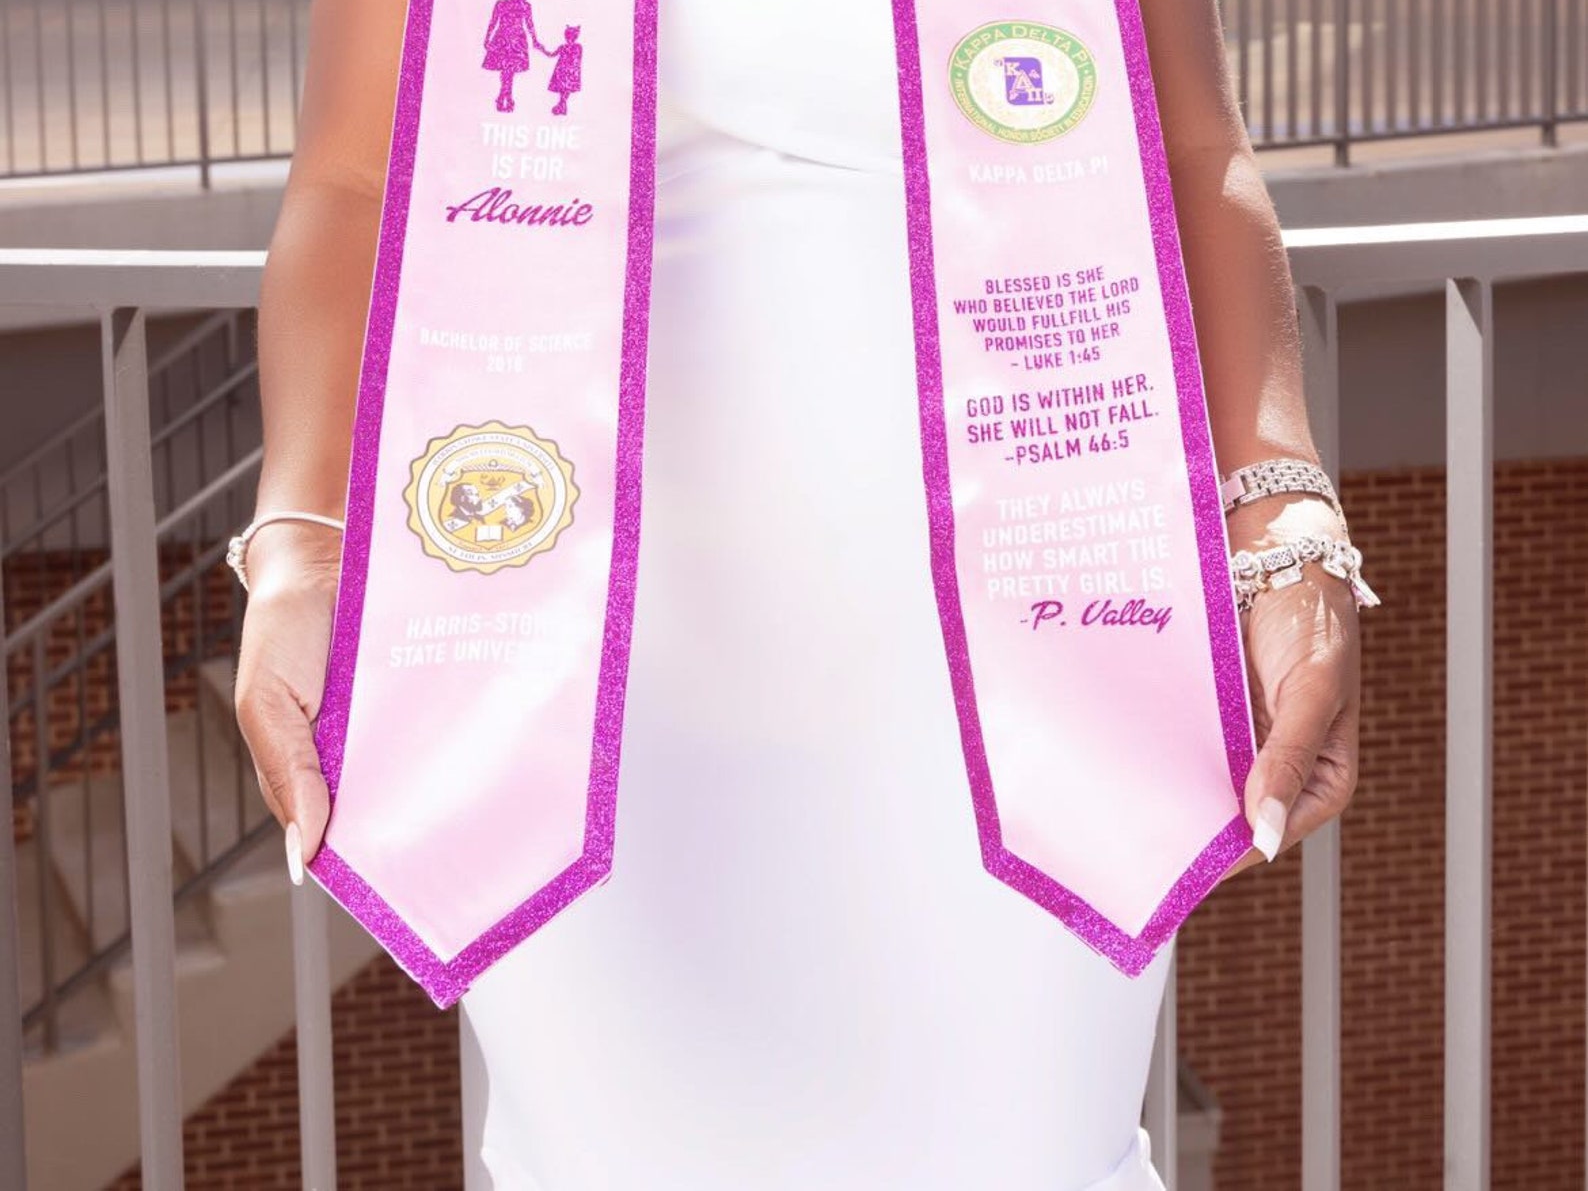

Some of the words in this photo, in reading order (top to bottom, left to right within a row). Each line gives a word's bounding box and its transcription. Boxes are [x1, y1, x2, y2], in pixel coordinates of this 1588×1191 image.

[955, 28, 1006, 70] KAPPA
[1012, 24, 1072, 54] DELTA
[481, 122, 529, 148] THIS
[535, 124, 582, 150] ONE
[492, 153, 513, 179] IS
[520, 154, 563, 180] FOR
[967, 162, 1027, 184] KAPPA
[1032, 159, 1085, 184] DELTA
[1090, 154, 1108, 176] PI
[446, 187, 594, 226] Alonnie
[953, 298, 987, 314] WHO
[993, 293, 1064, 313] BELIEVED
[1070, 287, 1097, 305] THE
[1101, 277, 1139, 300] LORD
[985, 275, 1051, 294] BLESSED
[1056, 273, 1071, 288] IS
[1076, 266, 1104, 285] SHE
[972, 316, 1026, 333] WOULD
[1032, 307, 1101, 330] FULLFILL
[1106, 300, 1131, 318] HIS
[420, 327, 498, 352] BACHELOR
[504, 335, 522, 352] OF
[528, 332, 594, 353] SCIENCE
[985, 332, 1062, 352] PROMISES
[1067, 329, 1085, 345] TO
[1091, 322, 1120, 342] HER
[1024, 351, 1063, 370] LUKE
[1069, 346, 1101, 365] 1:45
[967, 395, 1004, 418] GOD
[1012, 393, 1030, 412] IS
[1037, 383, 1105, 410] WITHIN
[1112, 373, 1154, 398] HER.
[967, 422, 1004, 444] SHE
[1010, 416, 1058, 438] WILL
[1065, 409, 1100, 432] NOT
[1108, 399, 1159, 425] FALL.
[1088, 430, 1129, 453] 46:5
[996, 494, 1051, 522] THEY
[1060, 479, 1146, 514] ALWAYS
[982, 504, 1167, 548] UNDERESTIMATE
[982, 549, 1034, 573] HOW
[1042, 541, 1120, 570] SMART
[1128, 533, 1171, 562] THE
[987, 573, 1070, 601] PRETTY
[1079, 570, 1133, 595] GIRL
[407, 611, 545, 640] HARRIS-STO
[1080, 598, 1173, 633] Valley
[388, 641, 447, 668] STATE
